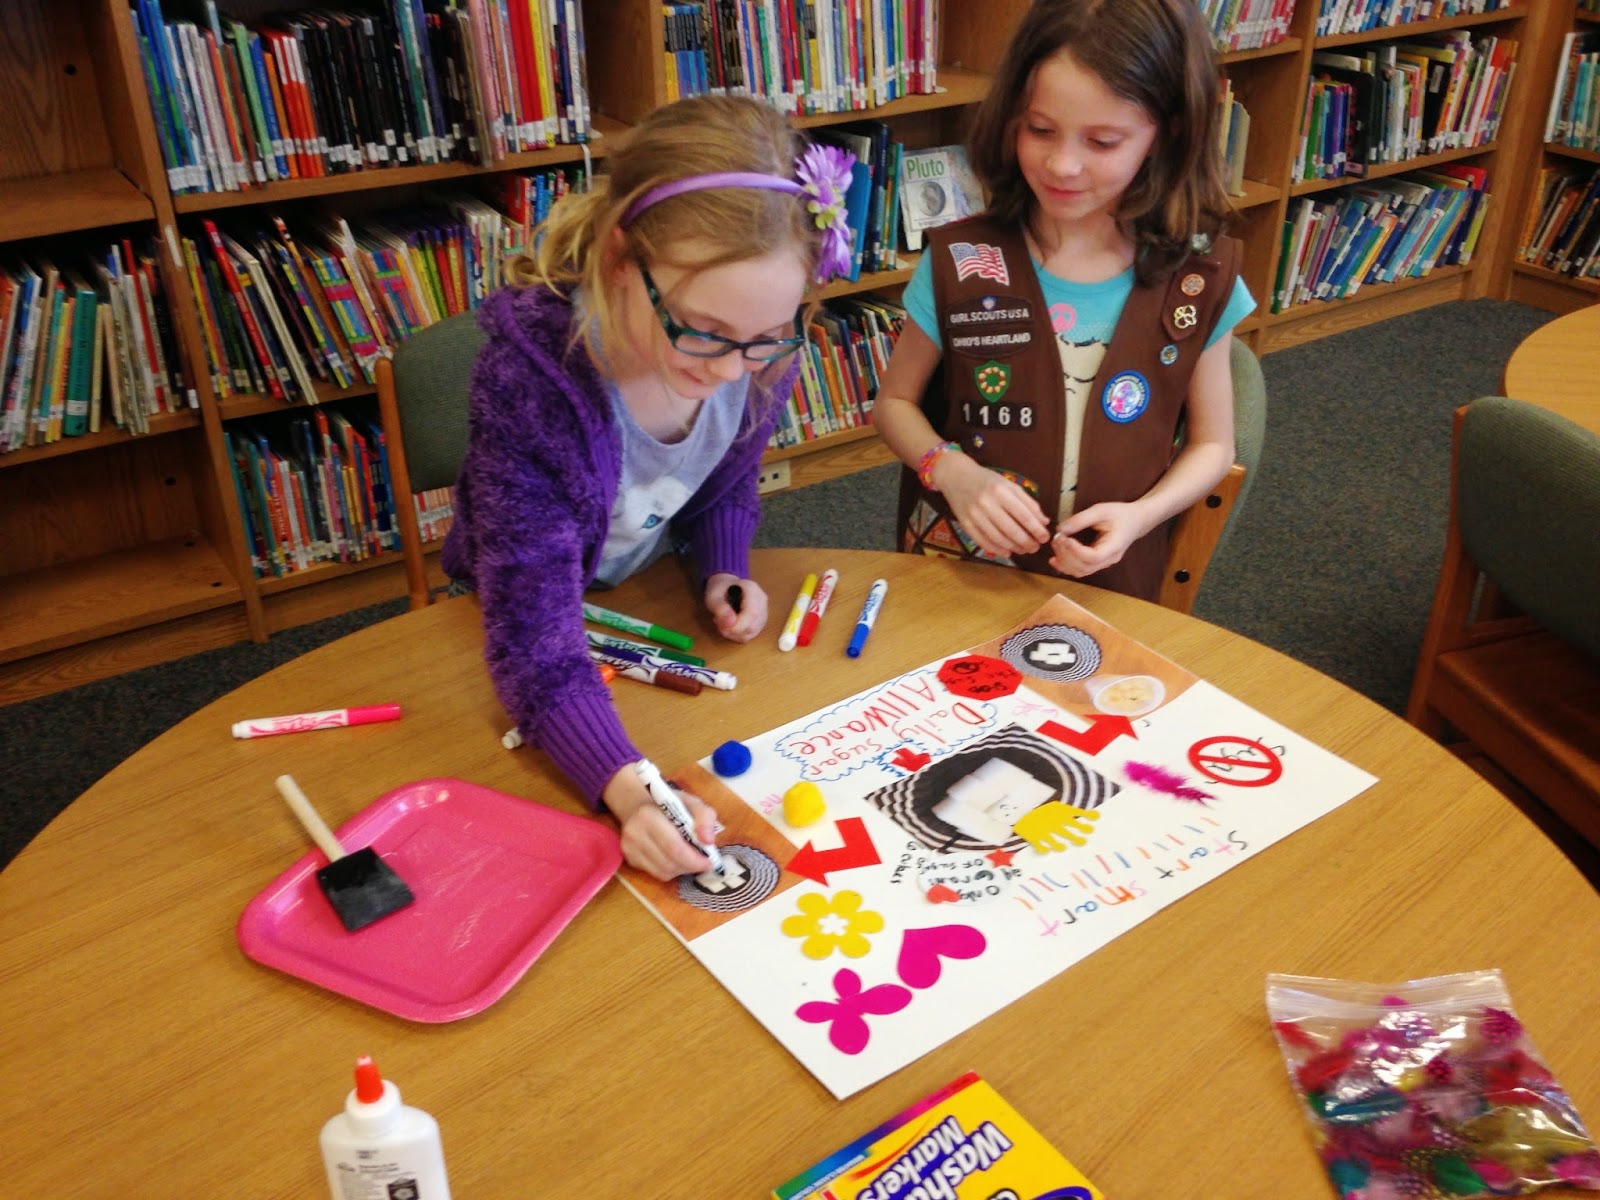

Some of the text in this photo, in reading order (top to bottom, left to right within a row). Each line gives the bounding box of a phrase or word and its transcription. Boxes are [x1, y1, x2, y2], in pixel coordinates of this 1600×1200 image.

[906, 157, 945, 179] Pluto
[949, 308, 1030, 324] GIRL SCOUTS USA
[981, 332, 1031, 346] HEARTLAND
[891, 702, 986, 744] Daily
[857, 1115, 967, 1199] Markers
